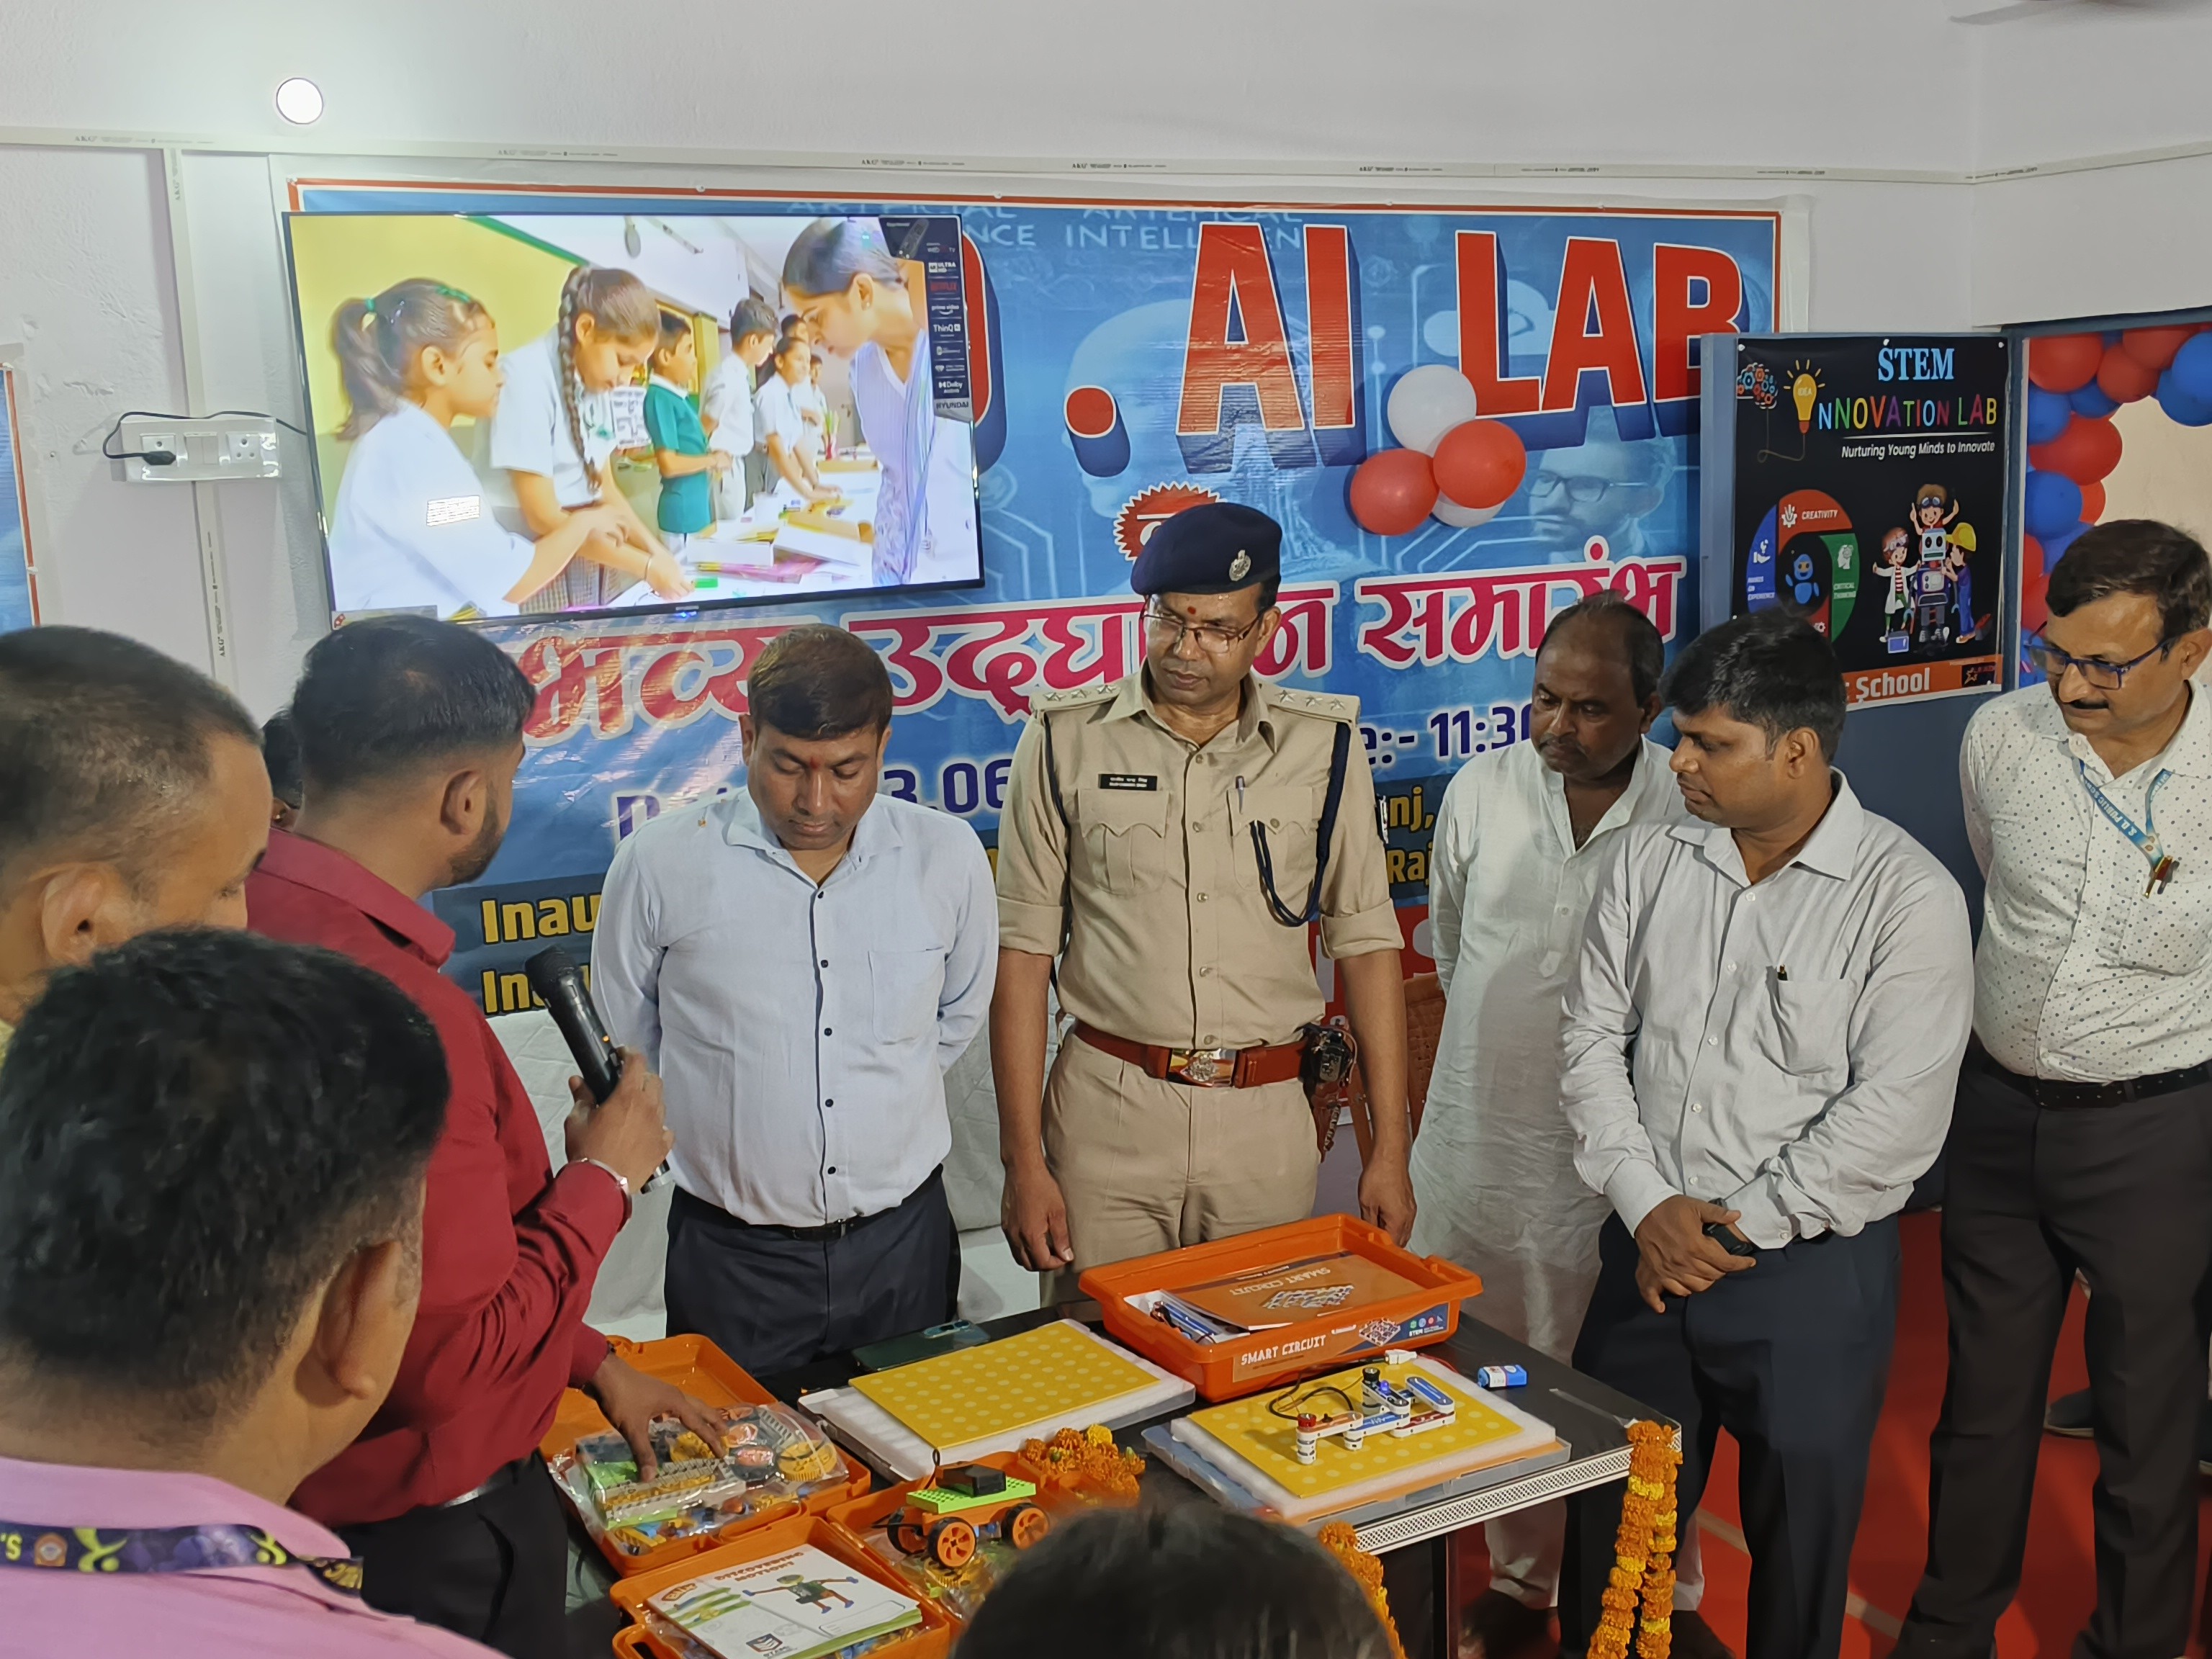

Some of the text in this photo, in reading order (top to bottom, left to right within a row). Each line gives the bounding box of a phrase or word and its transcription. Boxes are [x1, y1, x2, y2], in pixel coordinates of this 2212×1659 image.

[1175, 222, 1357, 436] AI
[1455, 229, 1743, 419] LAB
[1878, 348, 1955, 382] STEM
[936, 401, 969, 410] HYUNDAI
[1958, 394, 1997, 426] LAB
[1841, 440, 1995, 460] Nurturing Young Minds to Innovate
[1802, 509, 1838, 520] CREATIVITY
[1856, 667, 1930, 700] School
[1241, 1334, 1326, 1366] SMART CIRCUIT
